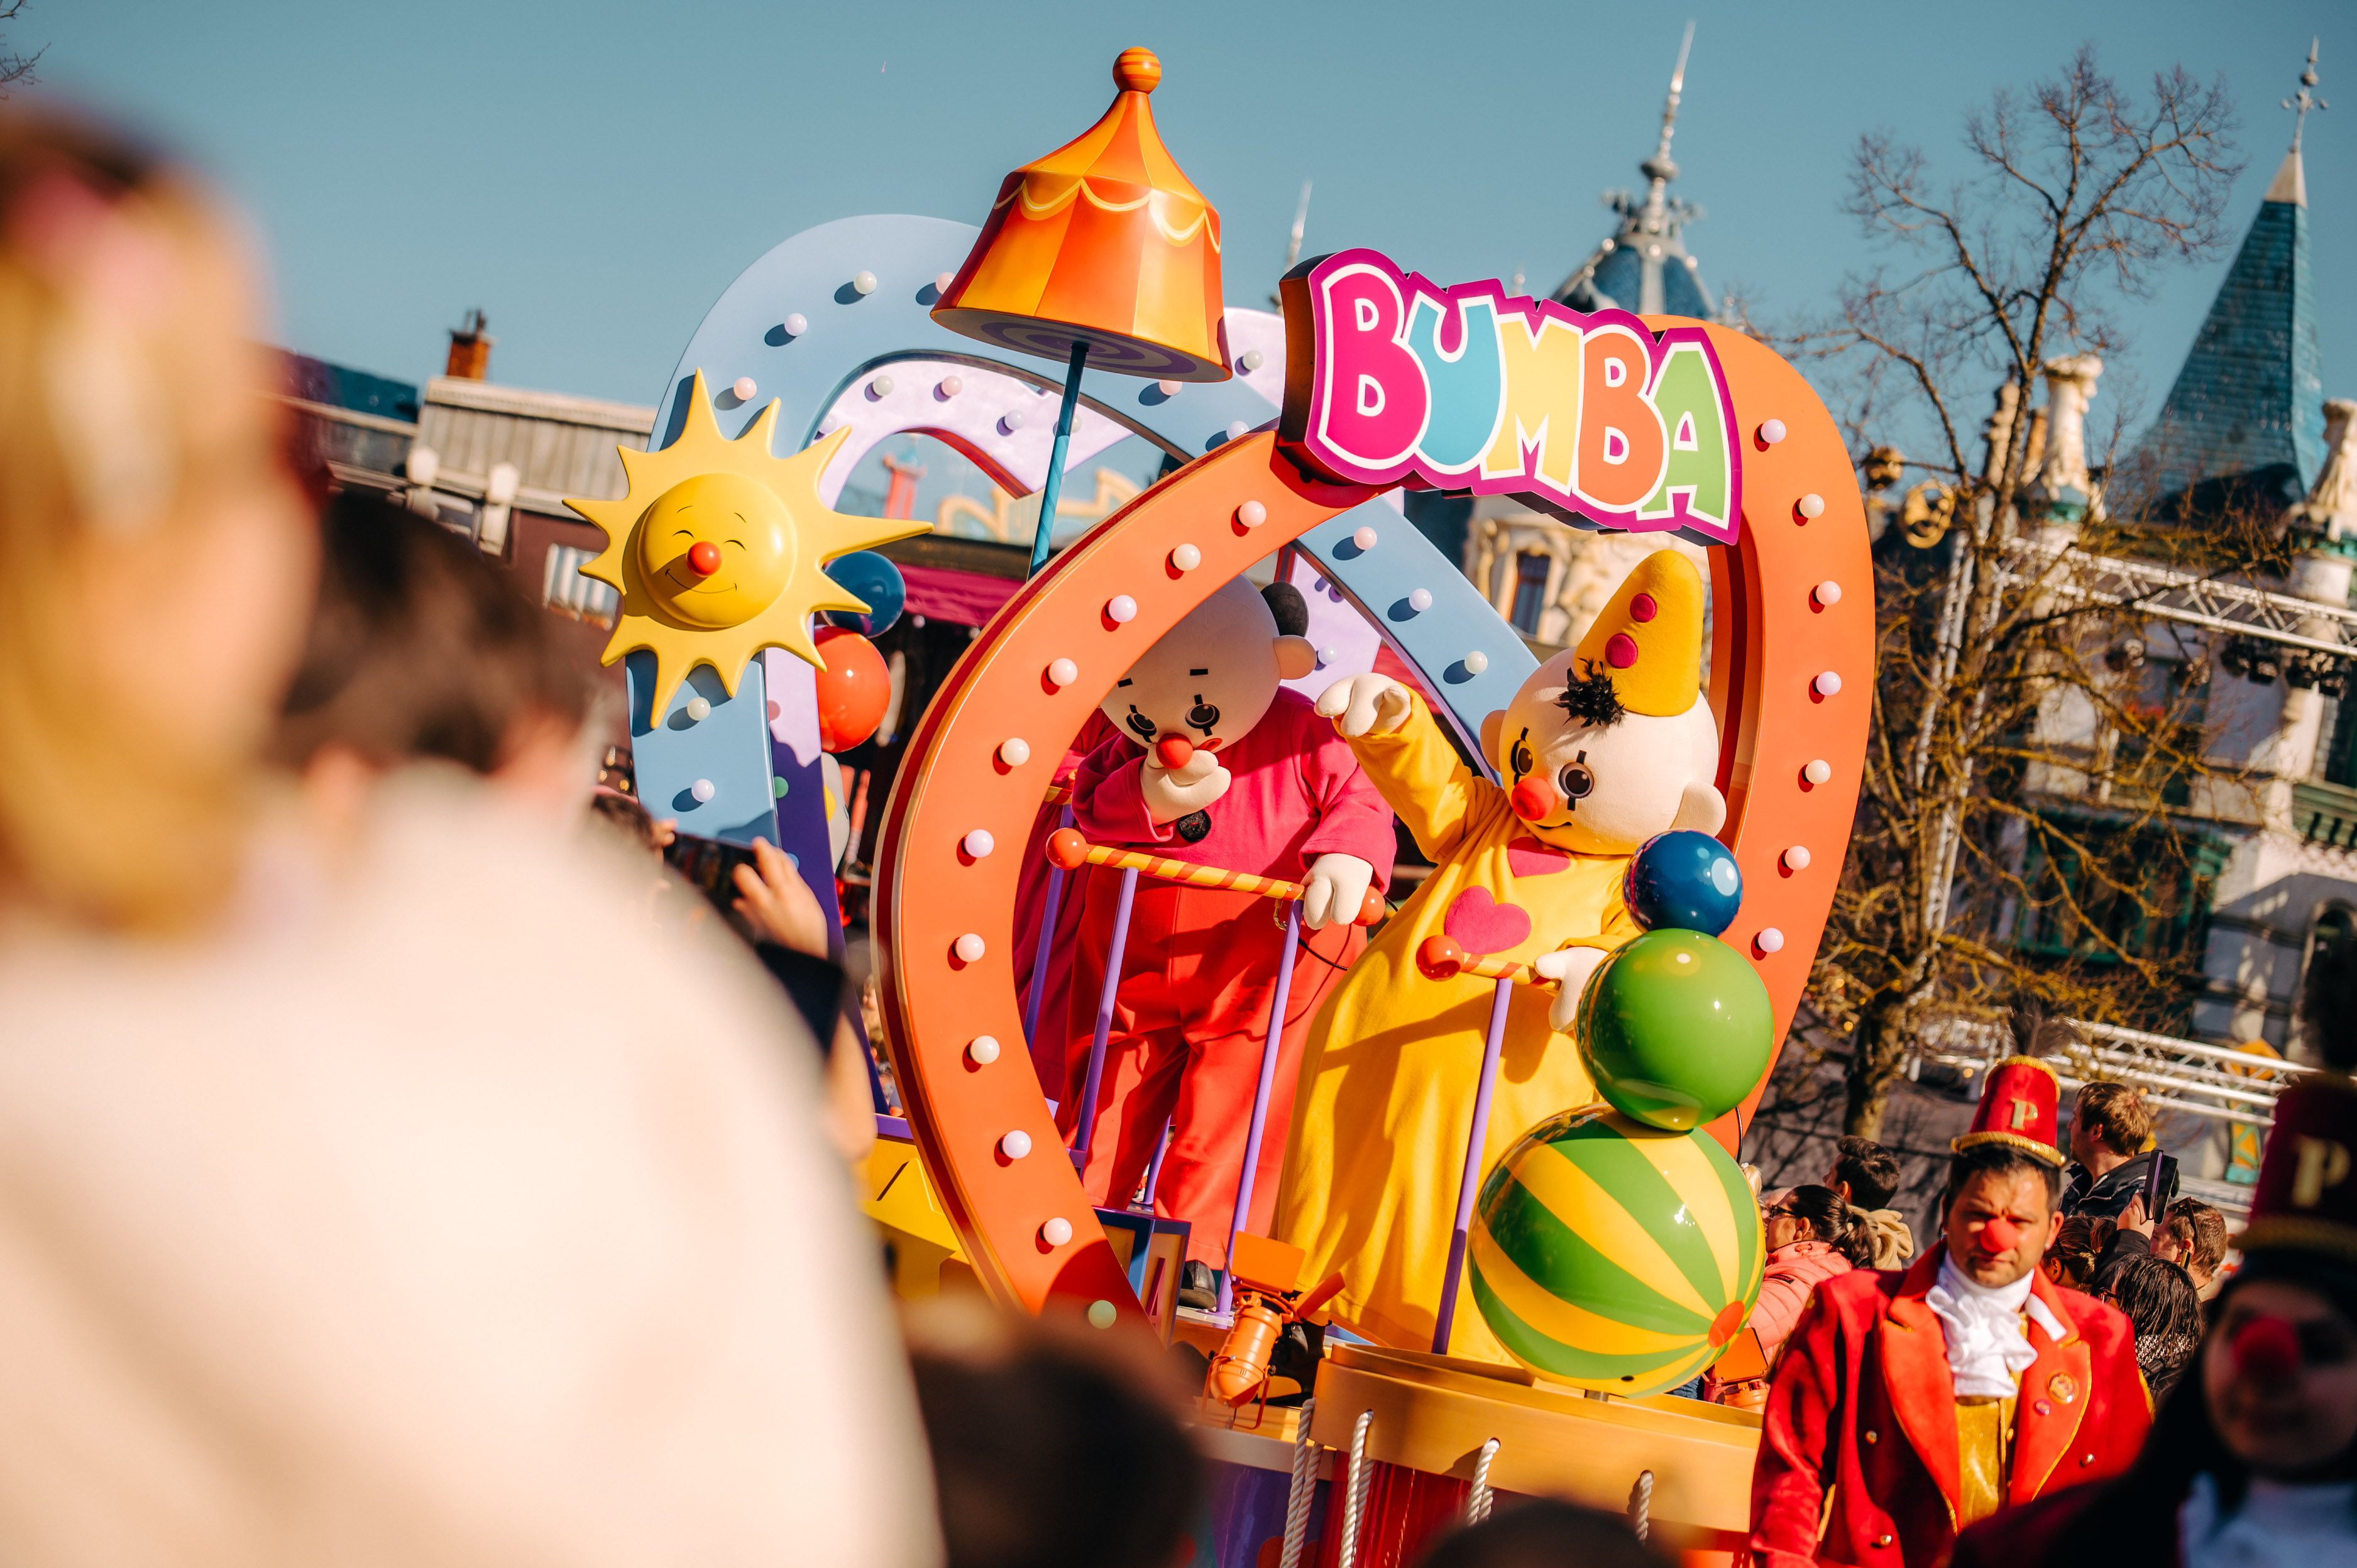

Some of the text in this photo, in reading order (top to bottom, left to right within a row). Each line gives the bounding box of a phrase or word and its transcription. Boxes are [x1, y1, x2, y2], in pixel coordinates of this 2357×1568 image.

[1318, 264, 1731, 529] BUMBA
[2009, 1097, 2038, 1131] P
[2291, 1135, 2351, 1207] P
